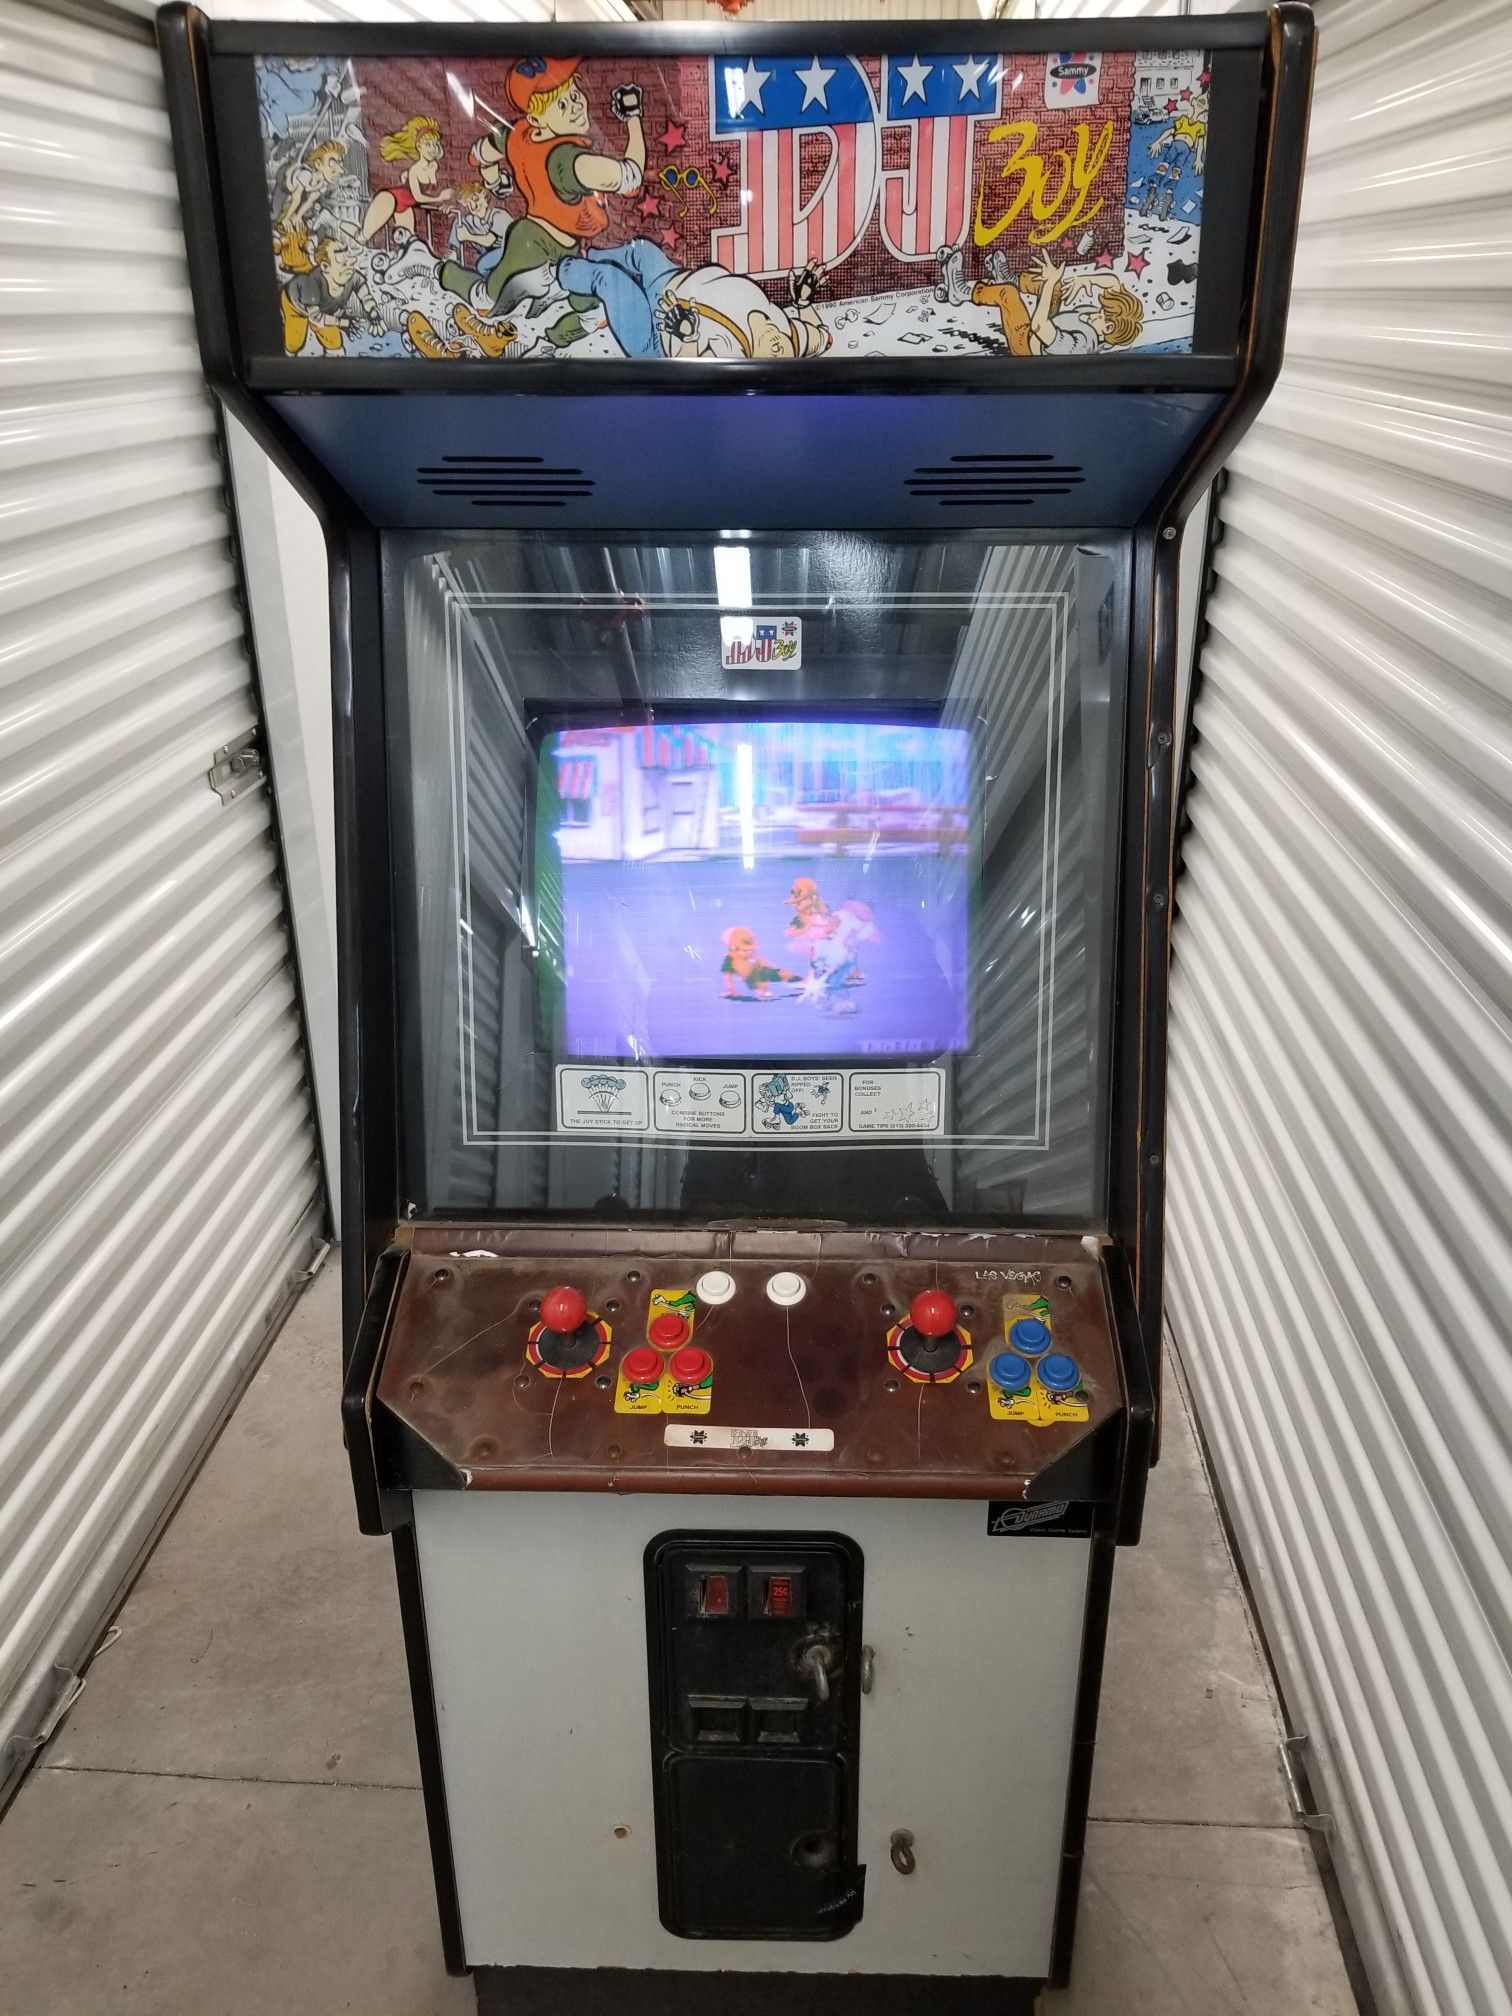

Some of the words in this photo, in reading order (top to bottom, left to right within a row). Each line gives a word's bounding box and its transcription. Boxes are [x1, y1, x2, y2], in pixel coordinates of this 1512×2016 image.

[1058, 66, 1089, 76] Sammy
[711, 53, 1003, 280] DJ
[839, 298, 869, 307] American
[870, 293, 894, 302] Sammy
[895, 287, 934, 298] Corporation
[975, 1270, 998, 1281] LAS
